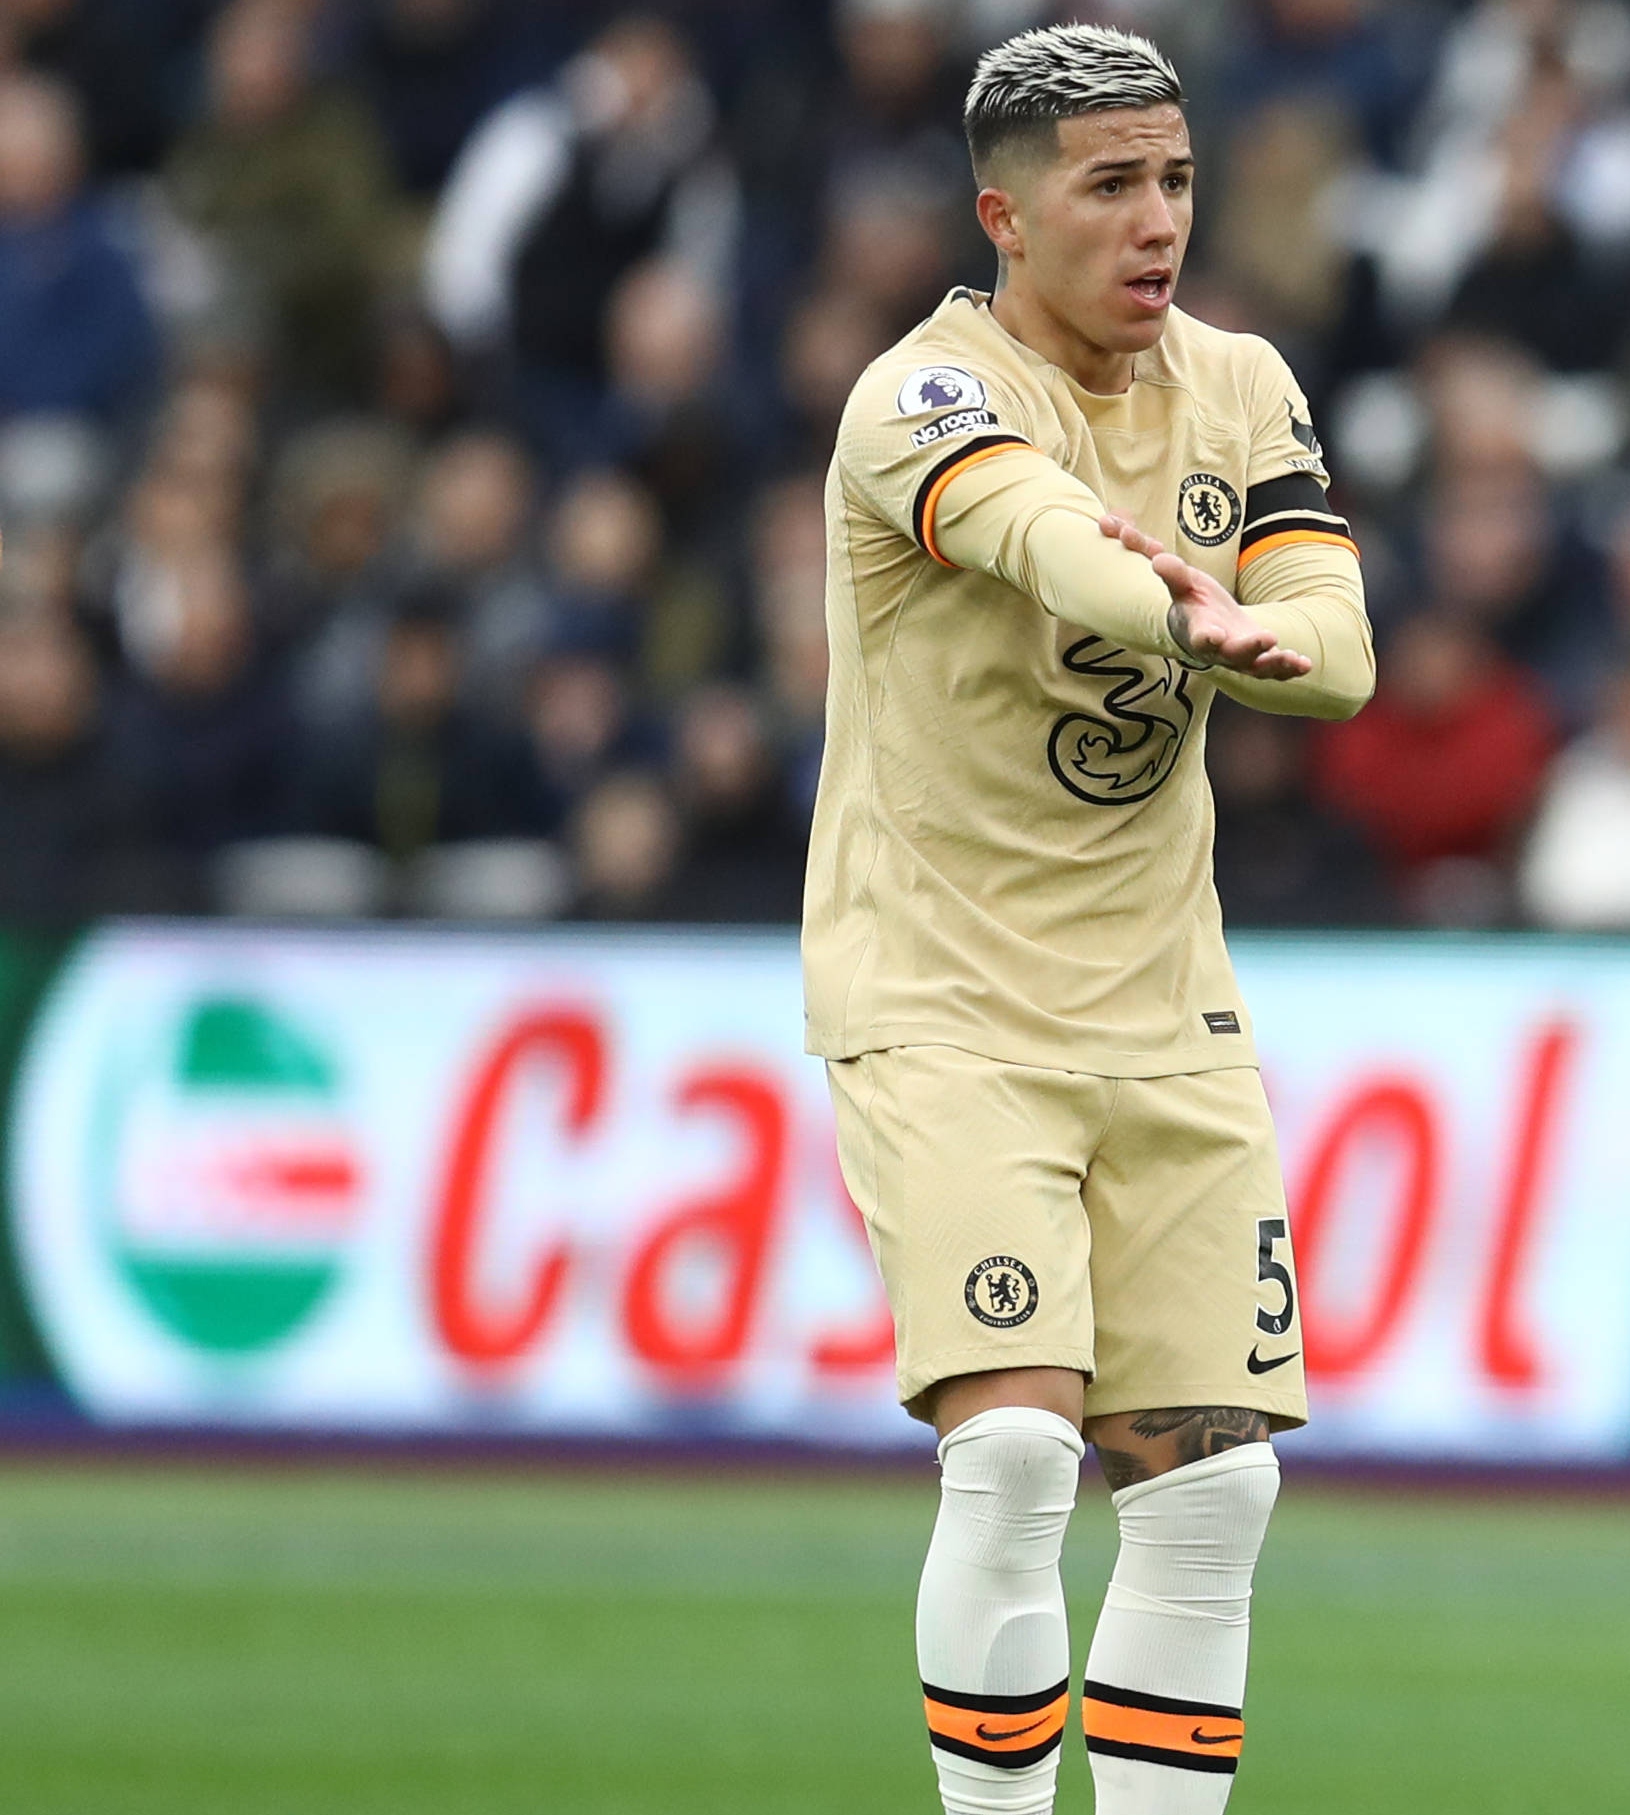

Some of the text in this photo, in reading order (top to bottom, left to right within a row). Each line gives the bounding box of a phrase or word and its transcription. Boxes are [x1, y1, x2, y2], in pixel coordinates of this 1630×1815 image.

[910, 426, 940, 449] No
[939, 410, 990, 434] room
[974, 1257, 1024, 1276] CHELSEA
[1256, 1217, 1294, 1336] 5
